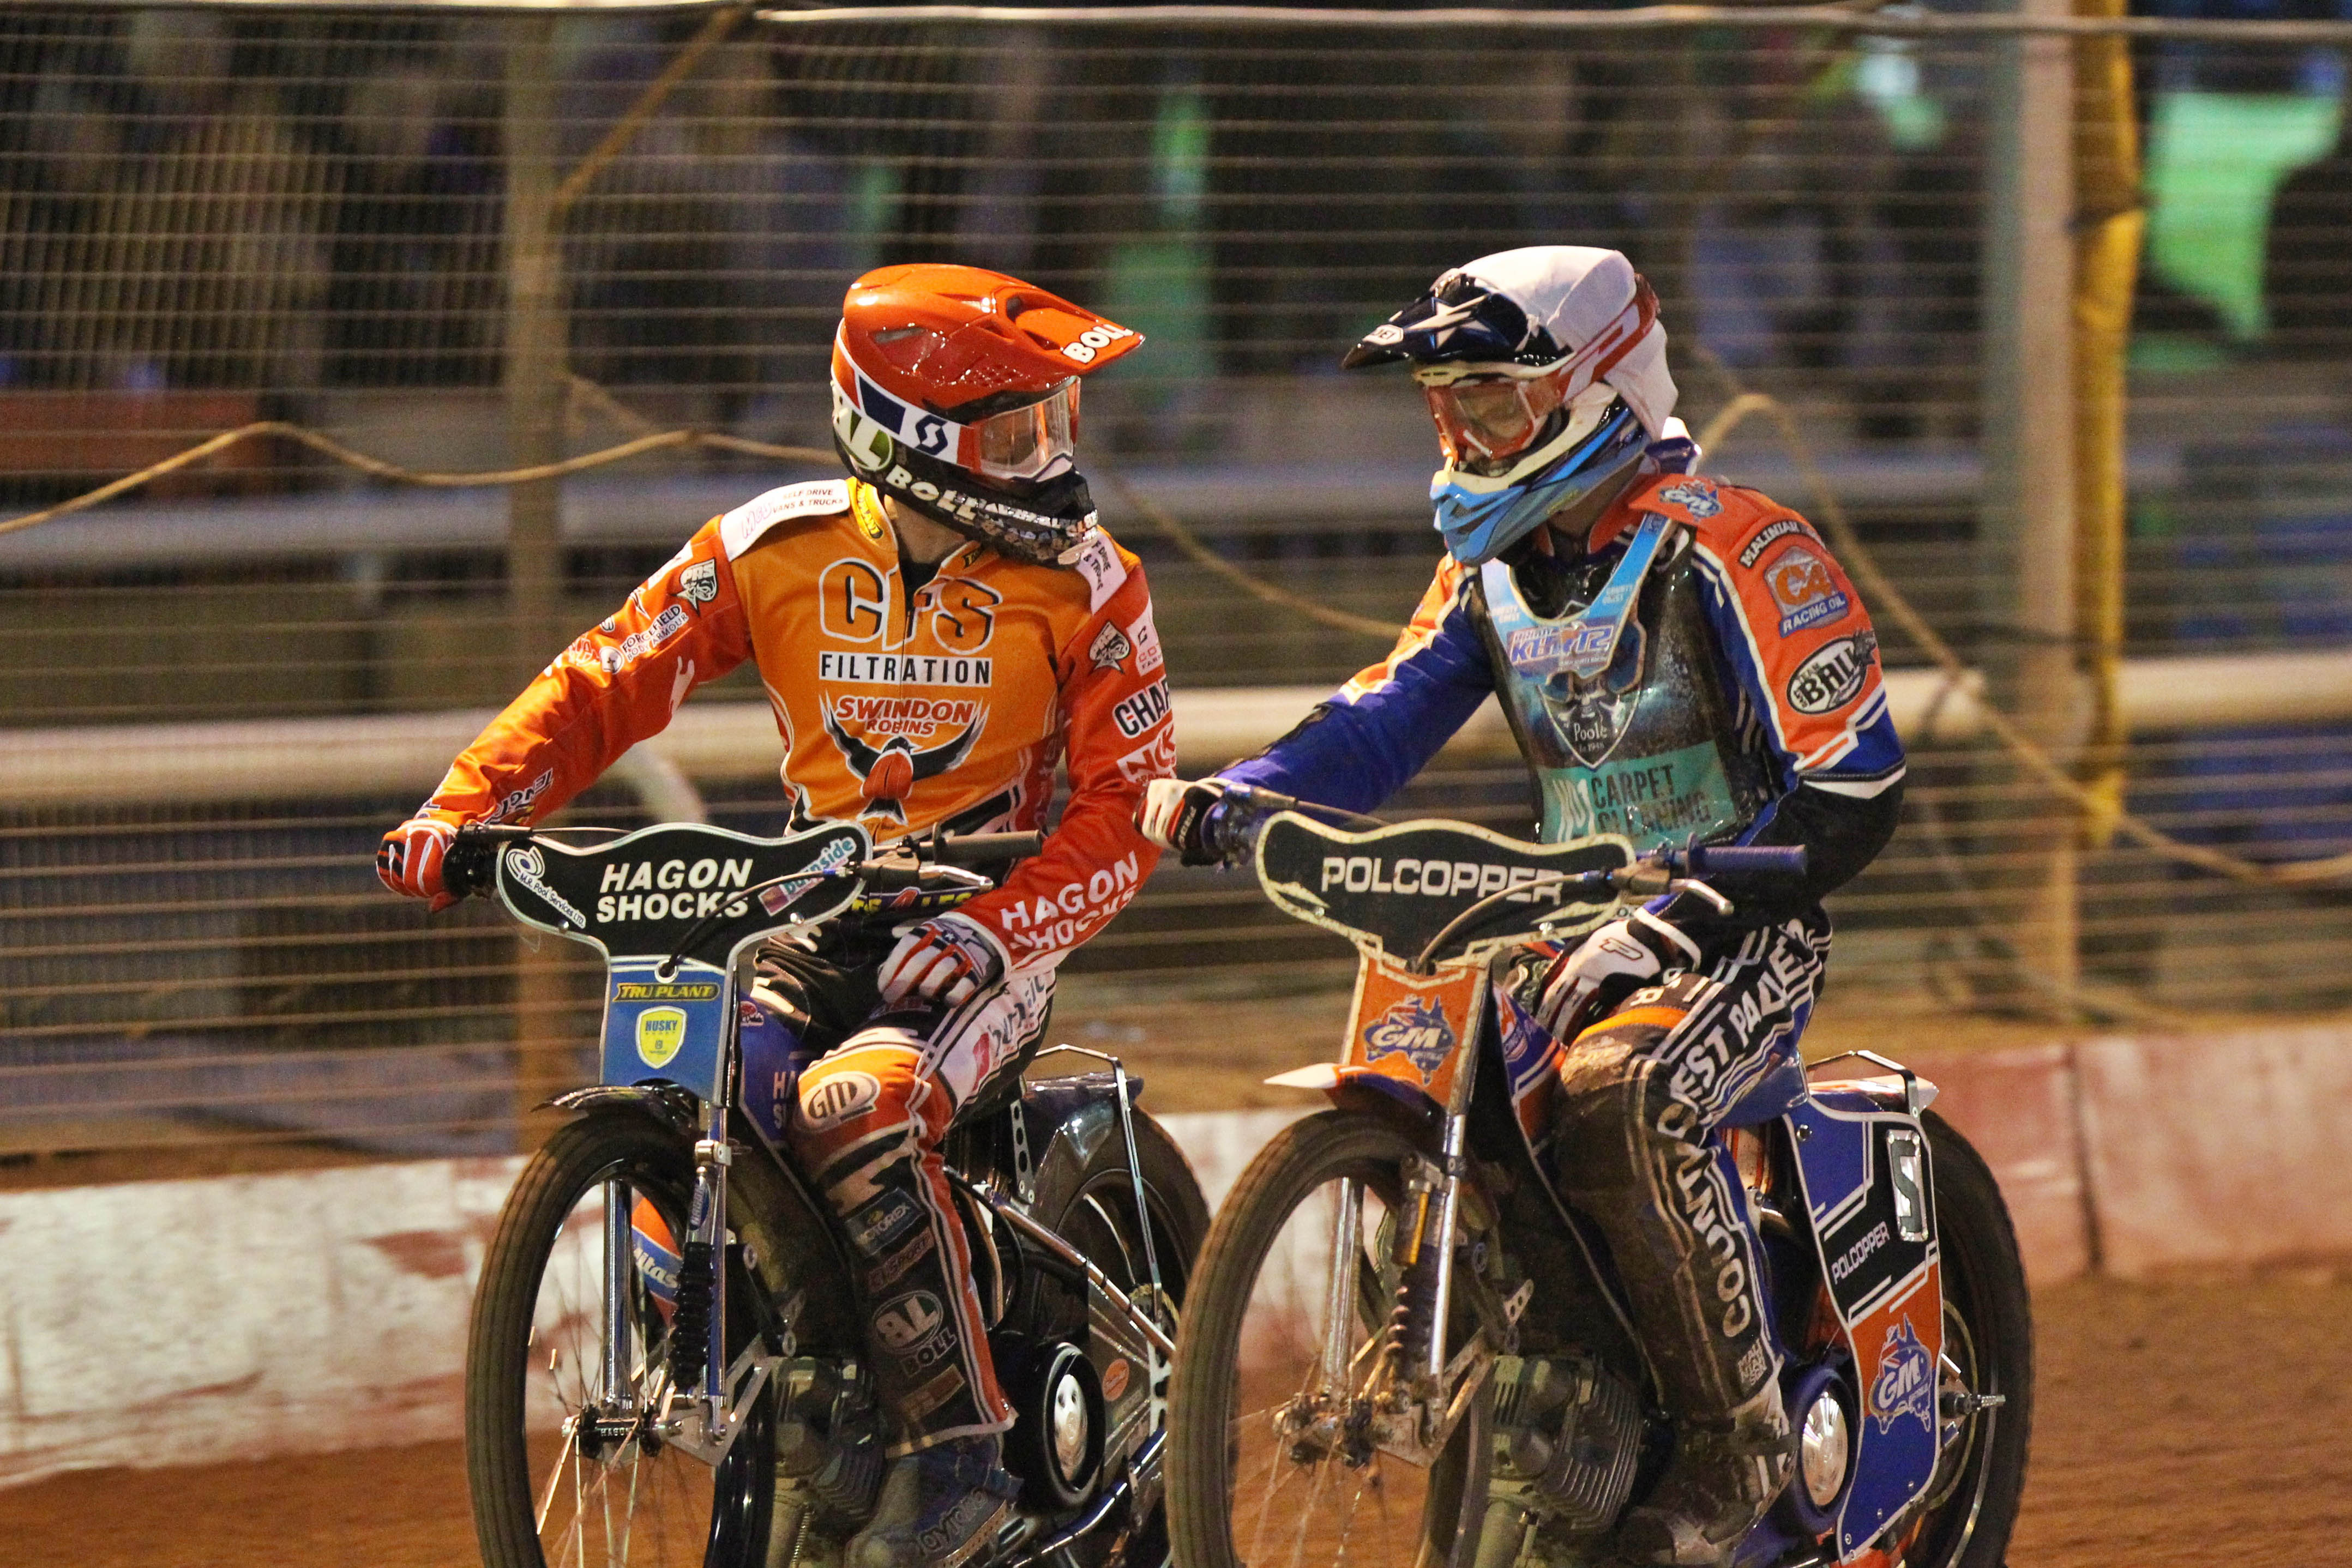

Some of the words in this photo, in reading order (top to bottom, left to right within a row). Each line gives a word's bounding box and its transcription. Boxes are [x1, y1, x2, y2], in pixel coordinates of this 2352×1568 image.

[1062, 323, 1135, 364] BOLL
[772, 502, 796, 514] VANS
[809, 498, 844, 506] TRUCKS
[886, 465, 978, 521] BOLL
[622, 605, 681, 653] FORCEFIELD
[652, 613, 689, 647] ARMOUR
[1783, 601, 1827, 634] RACING
[821, 654, 989, 684] FILTRATION
[837, 695, 976, 724] SWINDON
[866, 719, 936, 736] ROBINS
[1574, 722, 1608, 741] Poole
[1591, 764, 1674, 809] CARPET
[600, 859, 753, 892] HAGON
[1001, 852, 1139, 931] HAGON
[1322, 857, 1564, 905] POLCOPPER
[533, 882, 550, 898] Pool
[548, 893, 576, 917] Services
[597, 892, 749, 924] SHOCKS
[622, 986, 653, 998] TRU
[655, 985, 713, 997] PLANT
[646, 1020, 678, 1032] HUSKY
[1371, 1024, 1442, 1049] GM
[1831, 1221, 1890, 1285] POLCOPPER
[1878, 1353, 1922, 1409] GM
